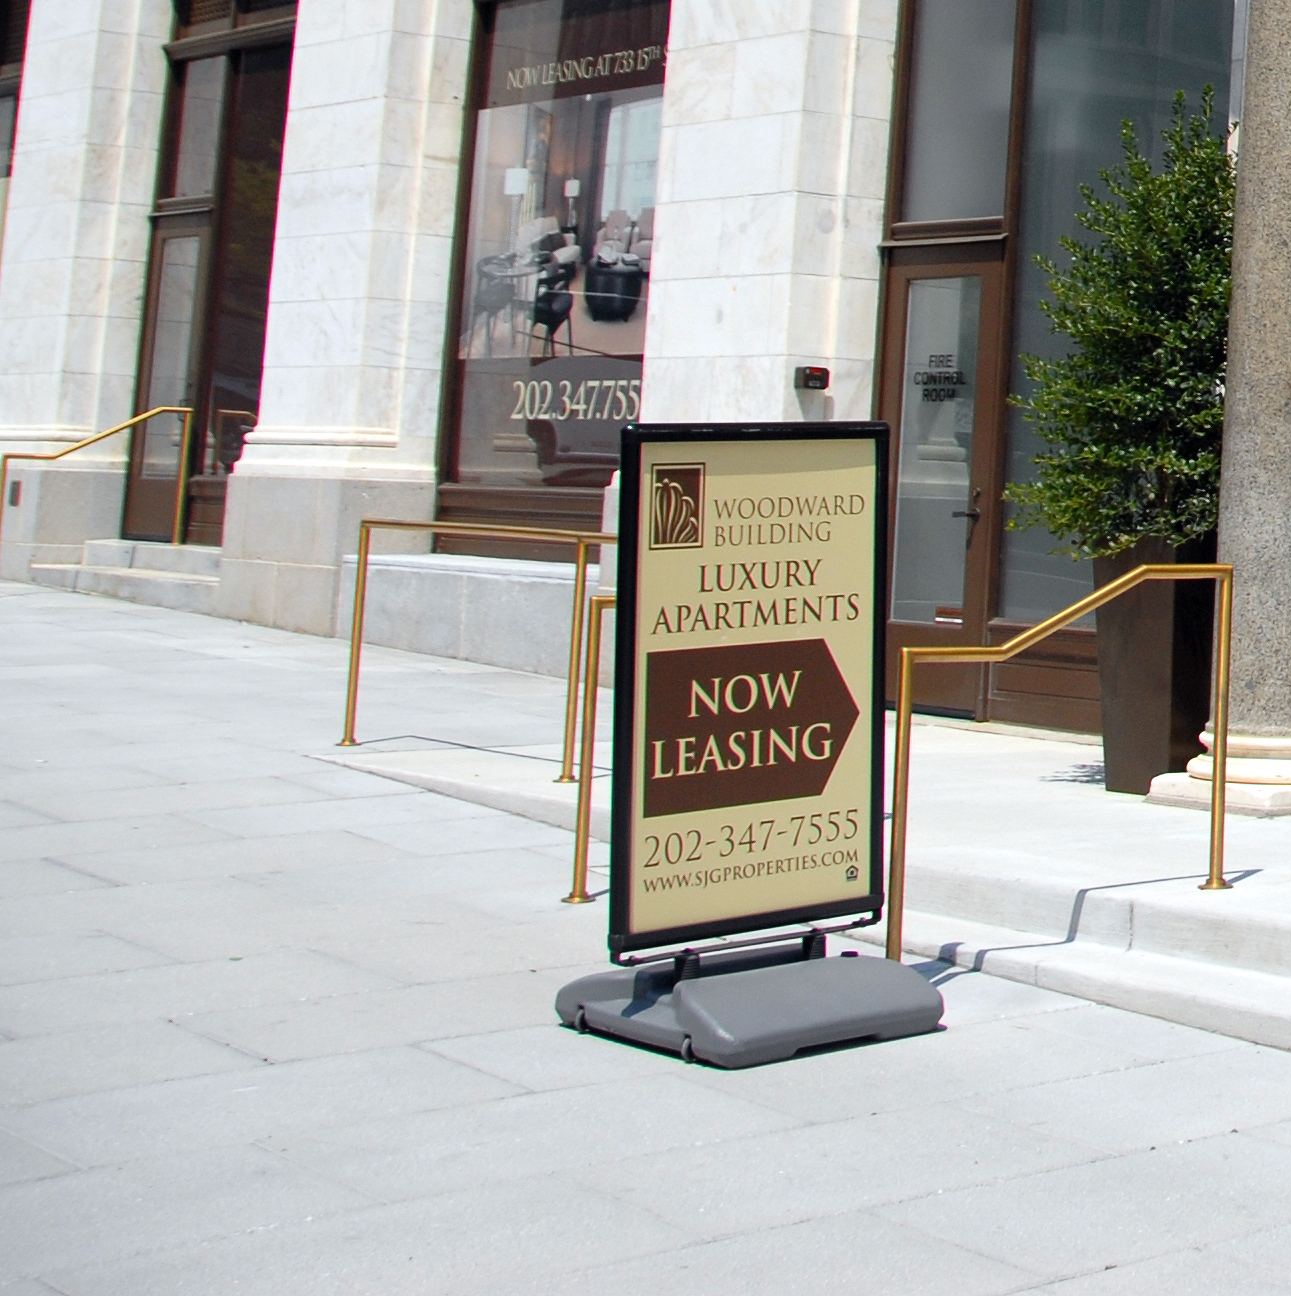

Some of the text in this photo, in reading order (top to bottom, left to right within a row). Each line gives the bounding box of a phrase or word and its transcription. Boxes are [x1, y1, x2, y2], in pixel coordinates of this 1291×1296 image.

[506, 65, 540, 91] NOW
[542, 56, 595, 86] LEASING
[594, 53, 613, 77] AT
[614, 49, 634, 74] 733
[913, 371, 966, 386] CONTROL
[929, 354, 953, 368] FIRE
[922, 388, 956, 402] ROOM
[713, 494, 865, 520] WOODWARD
[714, 520, 832, 547] BUILDING
[698, 558, 822, 593] LUXURY
[651, 593, 860, 636] APARTMENTS
[687, 670, 803, 718] NOW
[651, 722, 834, 780] LEASING
[643, 808, 859, 868] 202-347-7555
[642, 849, 859, 892] WWW.SJGPROPERTIES.COM
